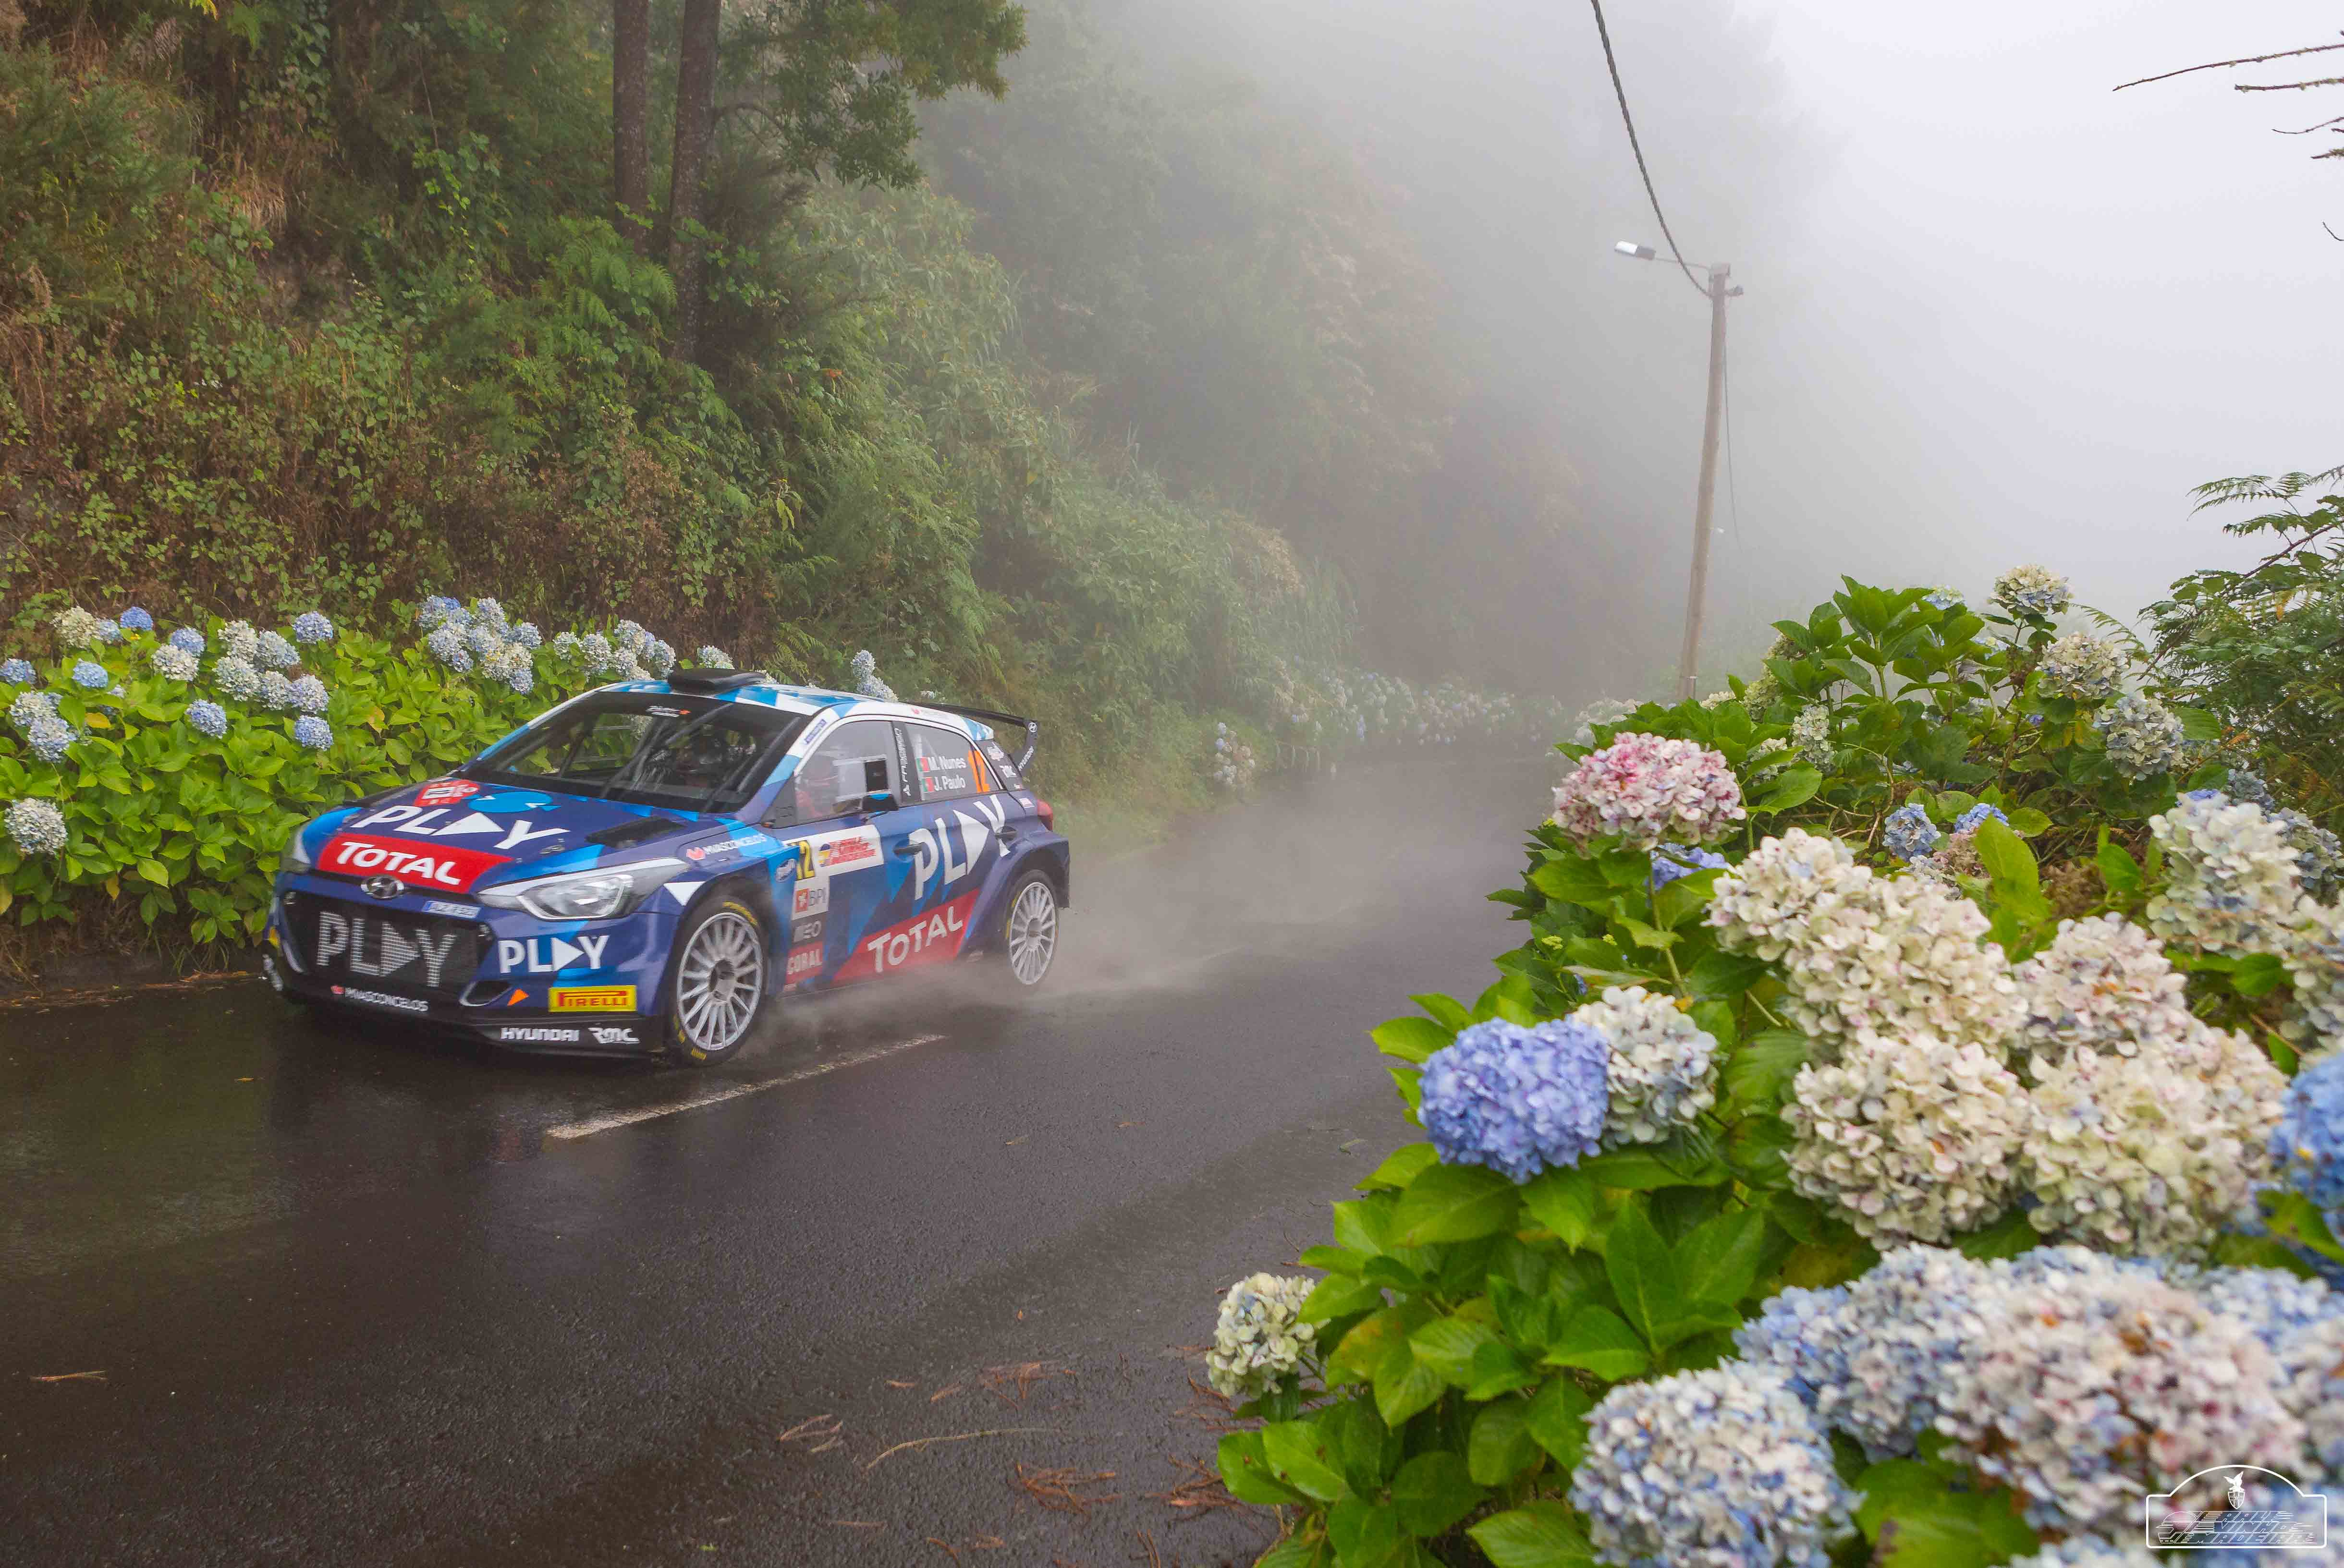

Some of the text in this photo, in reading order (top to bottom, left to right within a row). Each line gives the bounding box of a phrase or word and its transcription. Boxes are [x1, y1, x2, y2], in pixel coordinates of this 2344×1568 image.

[928, 756, 966, 770] M. Nunes
[934, 774, 966, 791] J. Paulo
[337, 841, 461, 886] TOTAL
[808, 887, 826, 907] BPI
[867, 906, 963, 972] TOTAL
[557, 990, 633, 1007] PIRELLI
[500, 1027, 580, 1042] HYUNDAI
[587, 1027, 641, 1044] RMC
